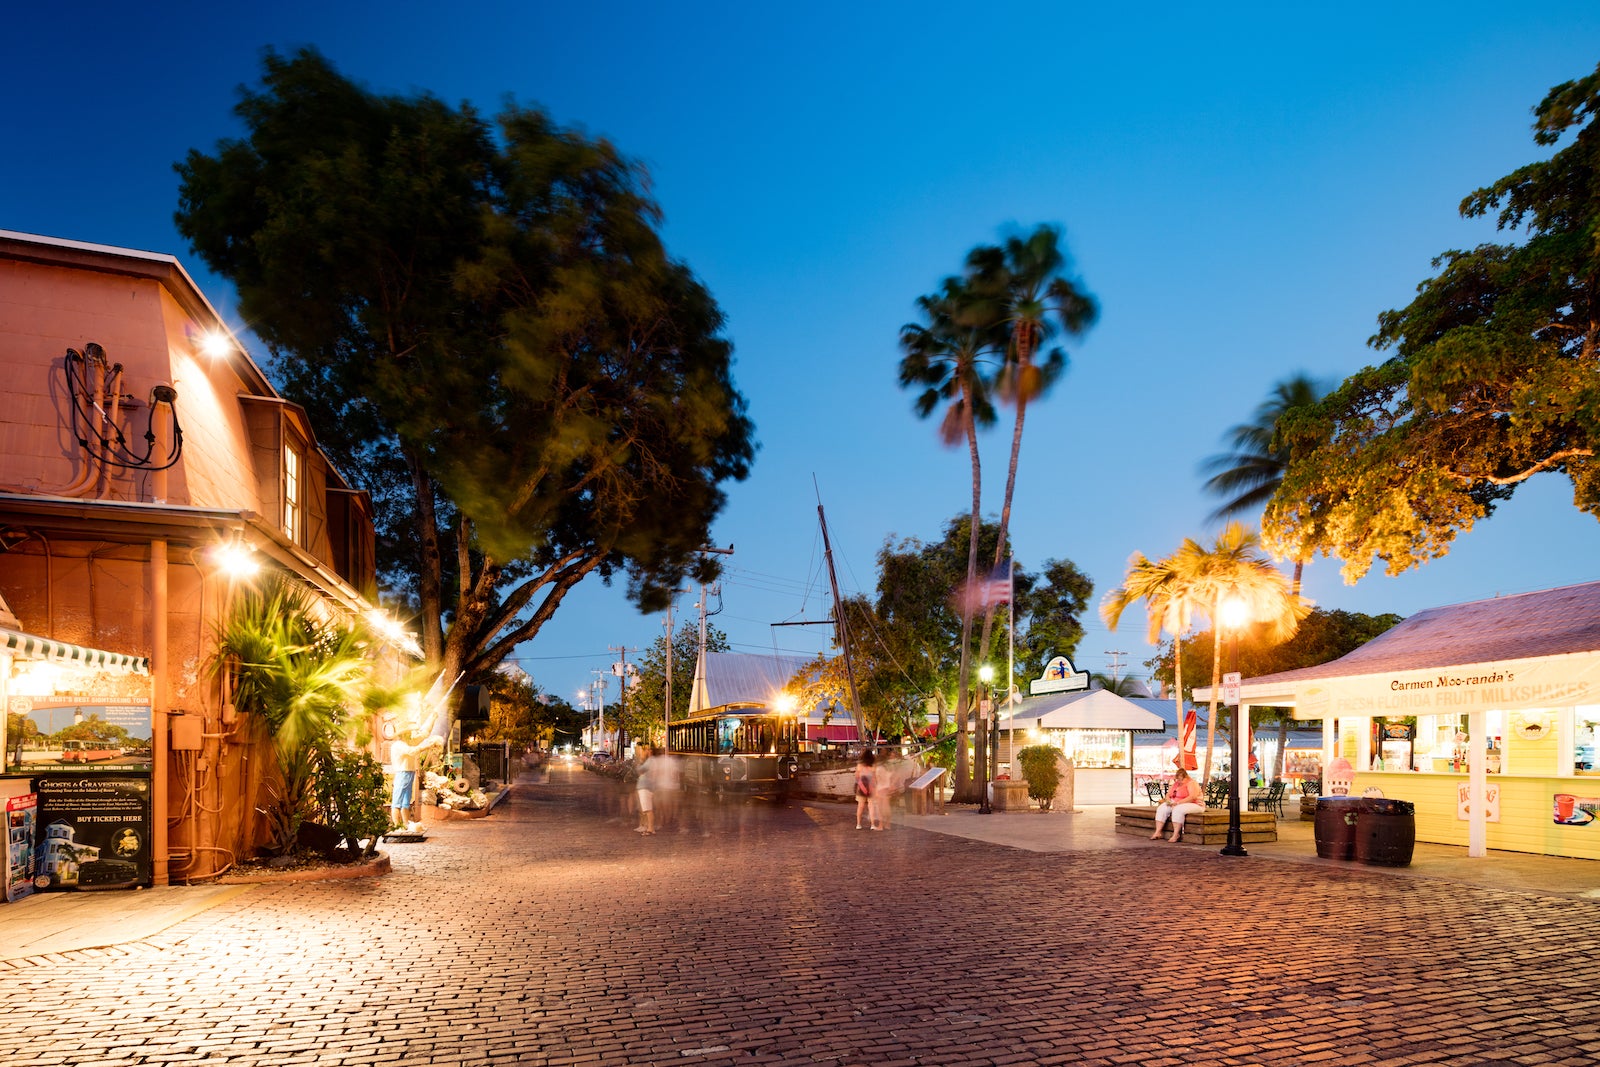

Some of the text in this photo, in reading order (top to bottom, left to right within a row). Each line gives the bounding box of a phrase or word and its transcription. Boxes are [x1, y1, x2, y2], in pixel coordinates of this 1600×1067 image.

[1390, 670, 1515, 691] Carmen Moo-randa's
[1337, 680, 1590, 710] FRESH FLORIDA FRUIT MILKSHAKES
